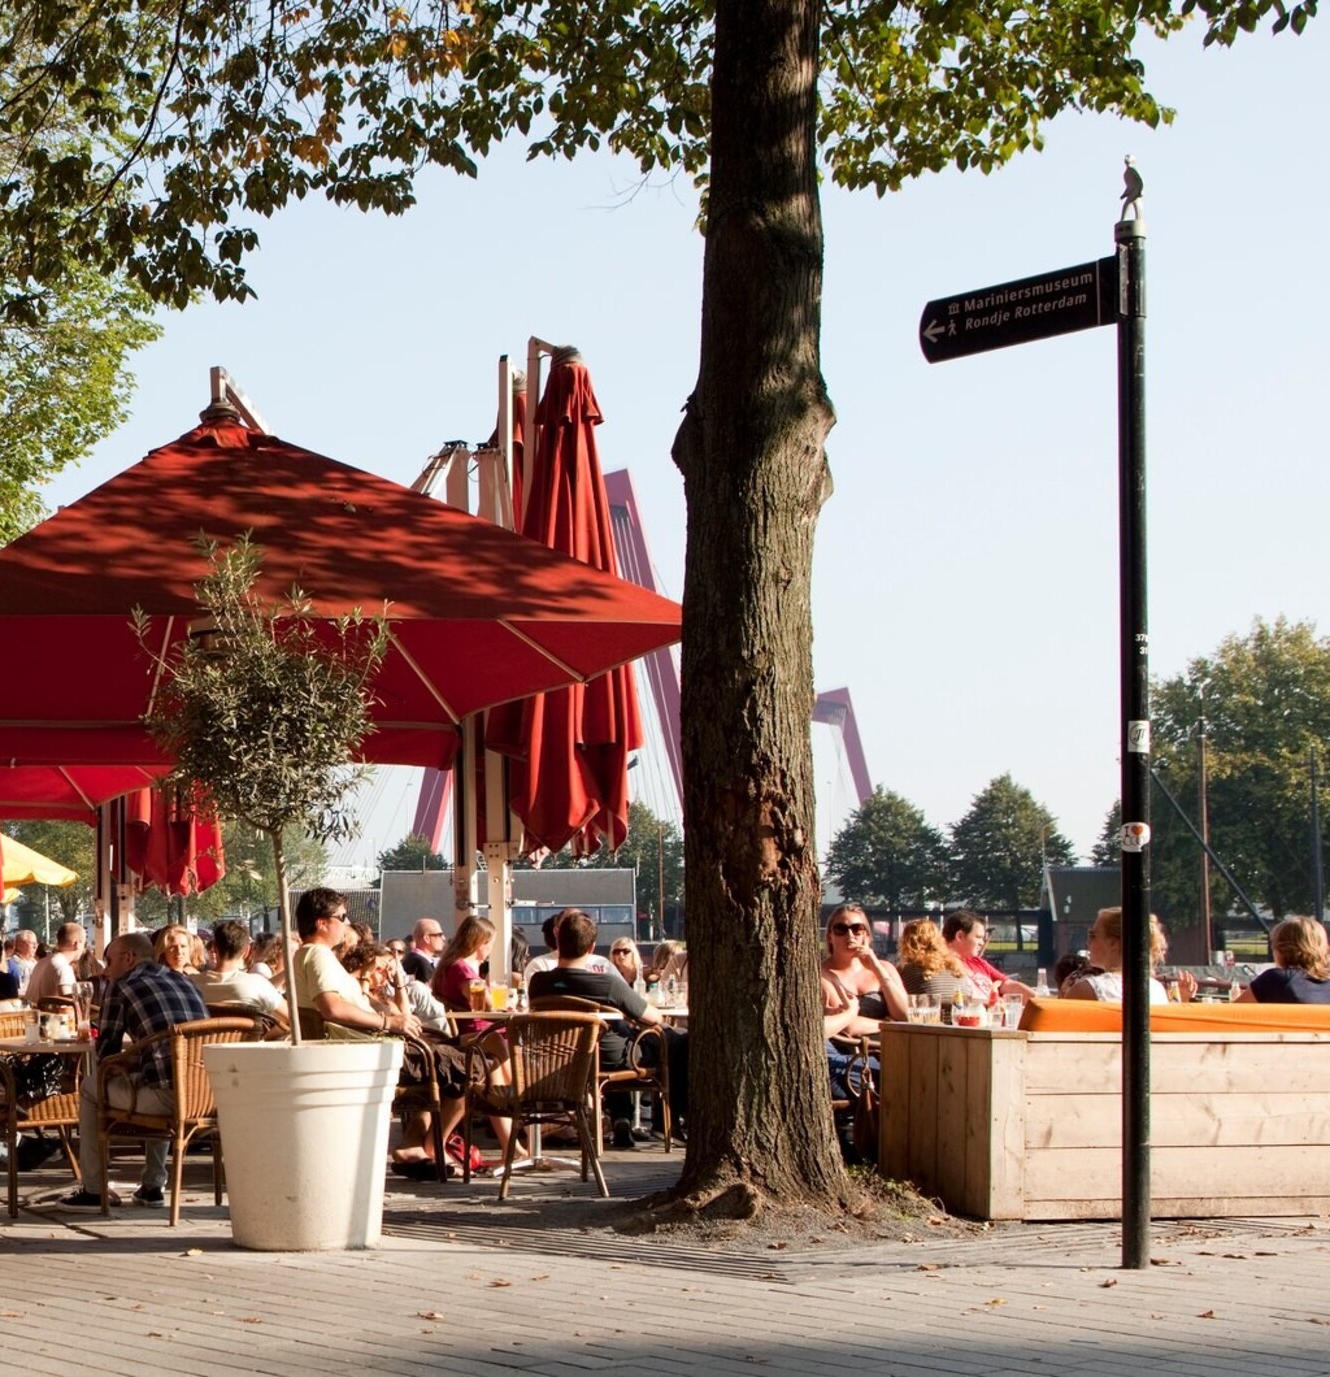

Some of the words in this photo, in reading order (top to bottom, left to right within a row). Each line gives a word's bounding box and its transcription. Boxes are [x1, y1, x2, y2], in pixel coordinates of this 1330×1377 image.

[964, 273, 1094, 312] Mariniersmuseum
[965, 310, 1011, 330] Rondje
[1014, 293, 1088, 319] Rotterdam
